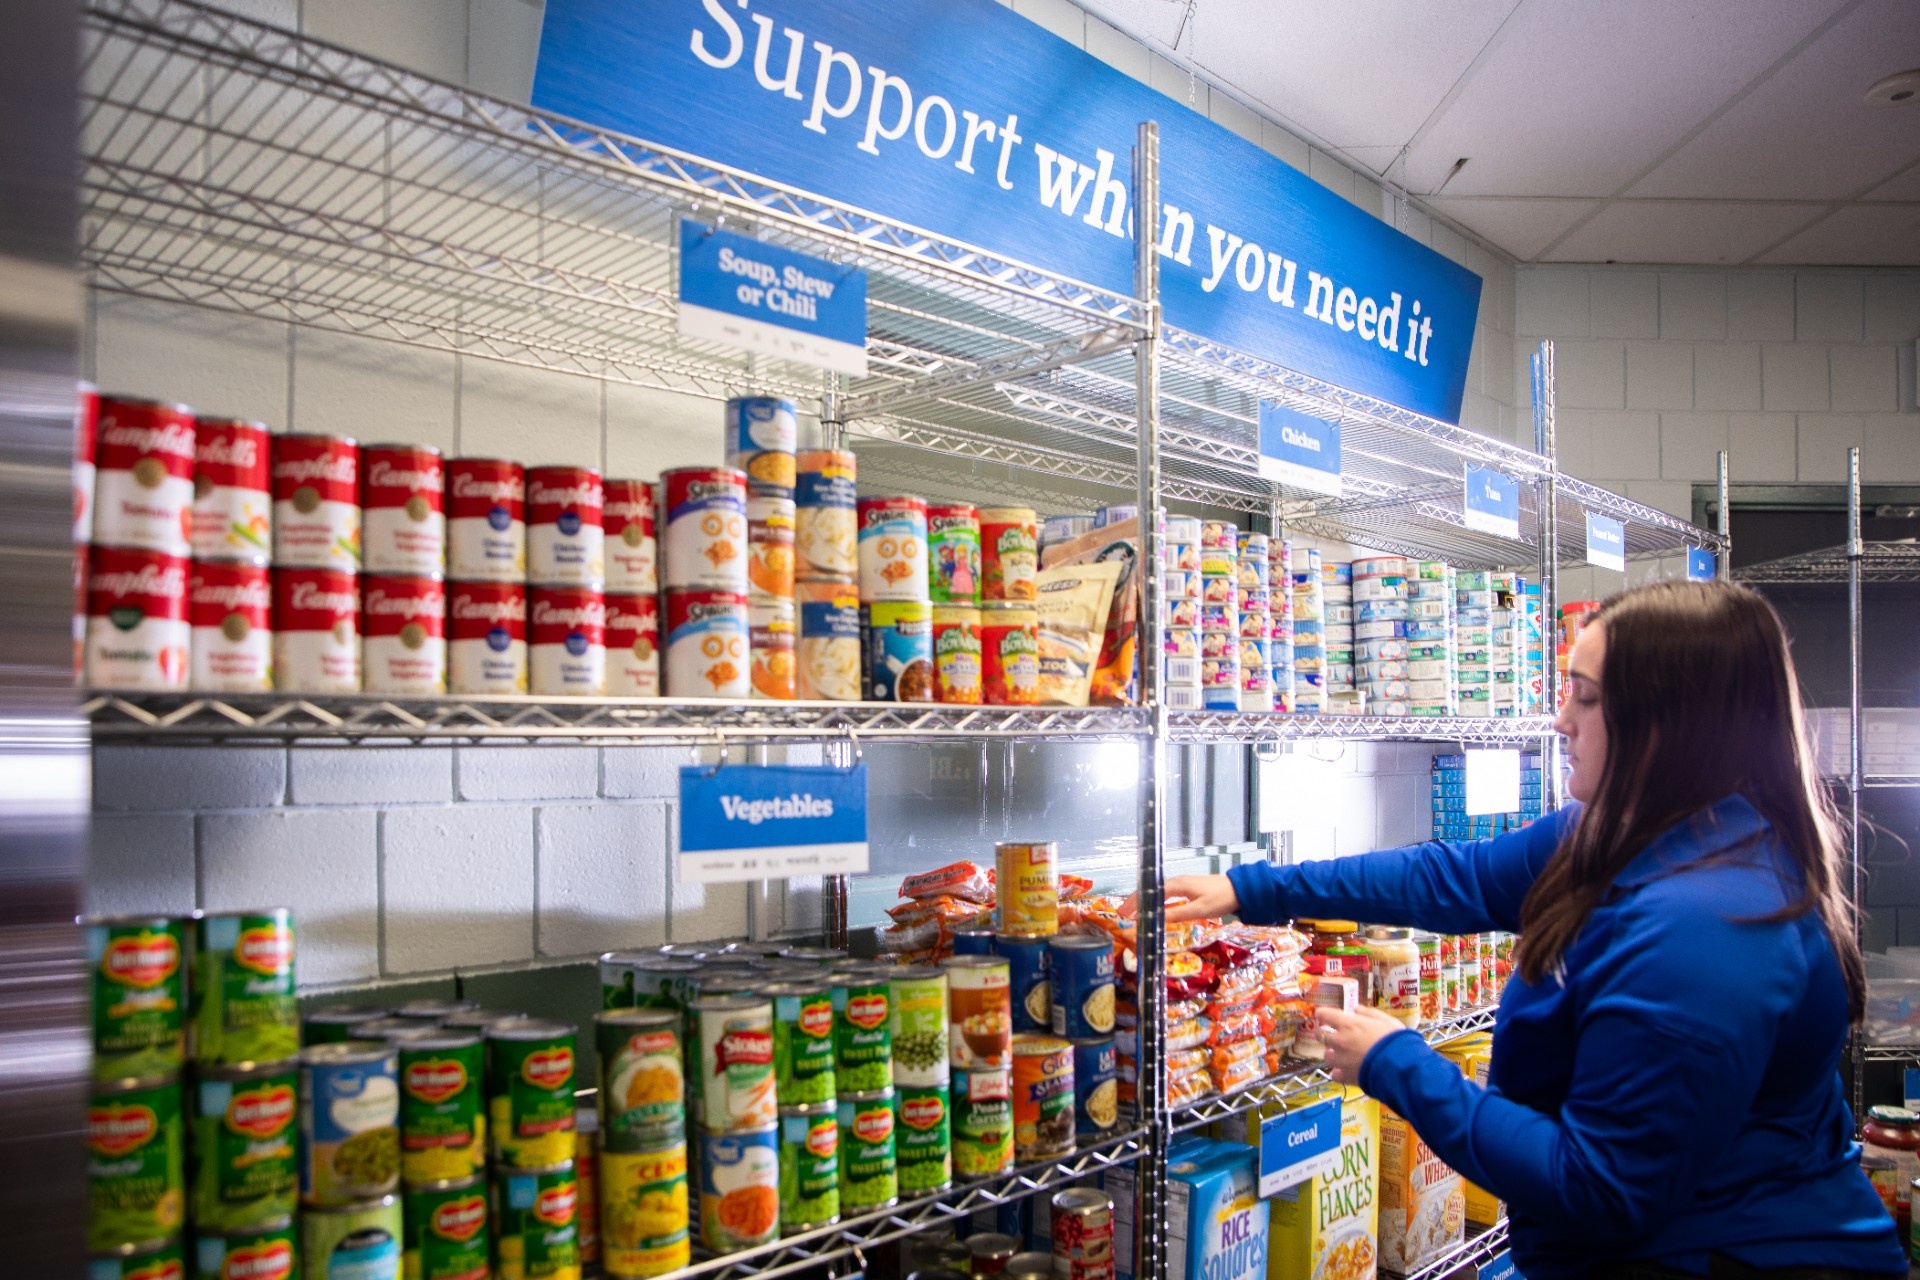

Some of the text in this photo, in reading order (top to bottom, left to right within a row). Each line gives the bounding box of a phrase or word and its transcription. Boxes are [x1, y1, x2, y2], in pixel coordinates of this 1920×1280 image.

[690, 0, 1433, 367] Support whn you need it
[718, 247, 835, 299] Soup, Stew
[736, 284, 817, 321] or Chili
[1281, 427, 1321, 452] Chicken
[1485, 484, 1502, 501] Tuna
[720, 793, 833, 824] Vegetables
[1288, 1123, 1318, 1148] Cereal
[1424, 1160, 1456, 1186] WHEA
[1319, 1175, 1373, 1233] FLAKES
[1222, 1210, 1251, 1249] RICE
[1200, 1228, 1266, 1280] squares
